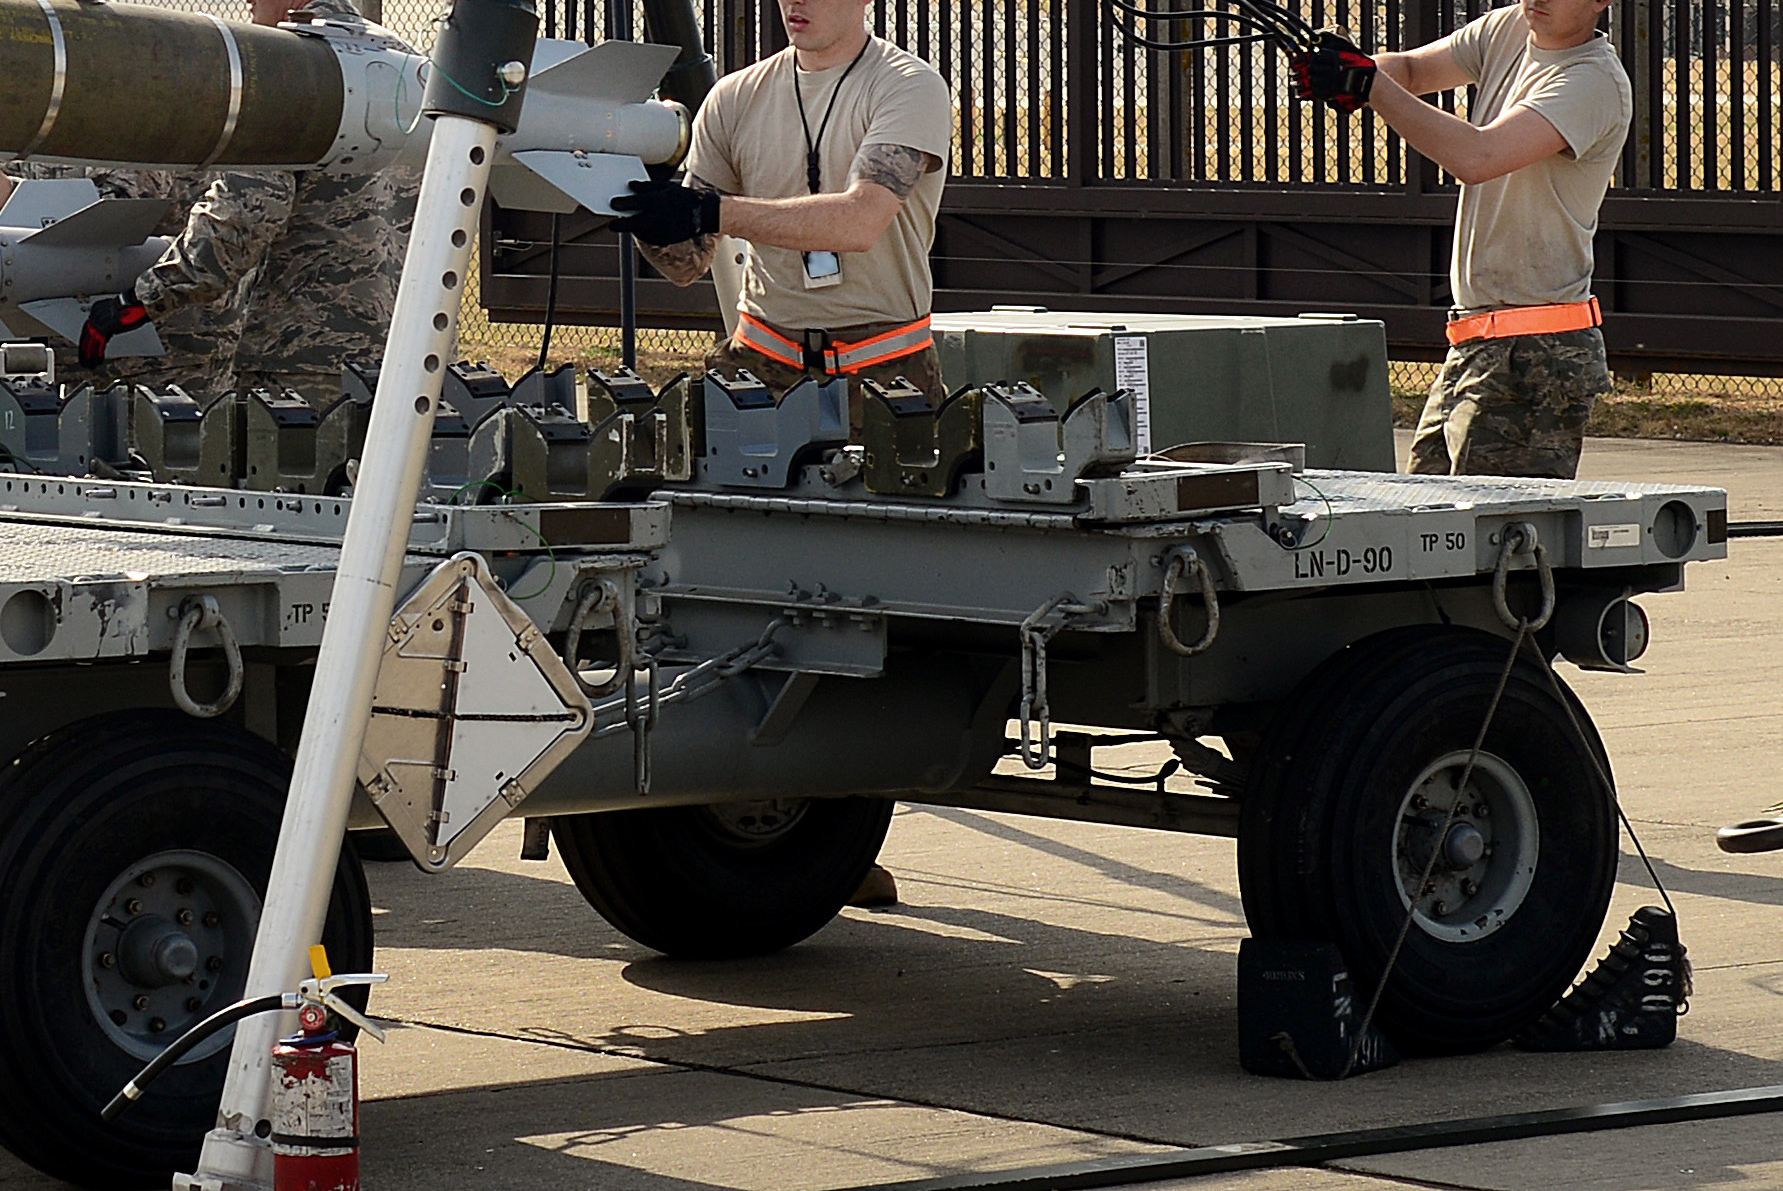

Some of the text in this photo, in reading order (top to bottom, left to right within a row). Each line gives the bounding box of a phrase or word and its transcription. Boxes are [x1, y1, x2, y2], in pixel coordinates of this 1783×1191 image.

[5, 410, 15, 430] 12
[1419, 532, 1466, 552] TP 50
[1294, 546, 1393, 579] LN-D-90
[291, 603, 314, 624] TP
